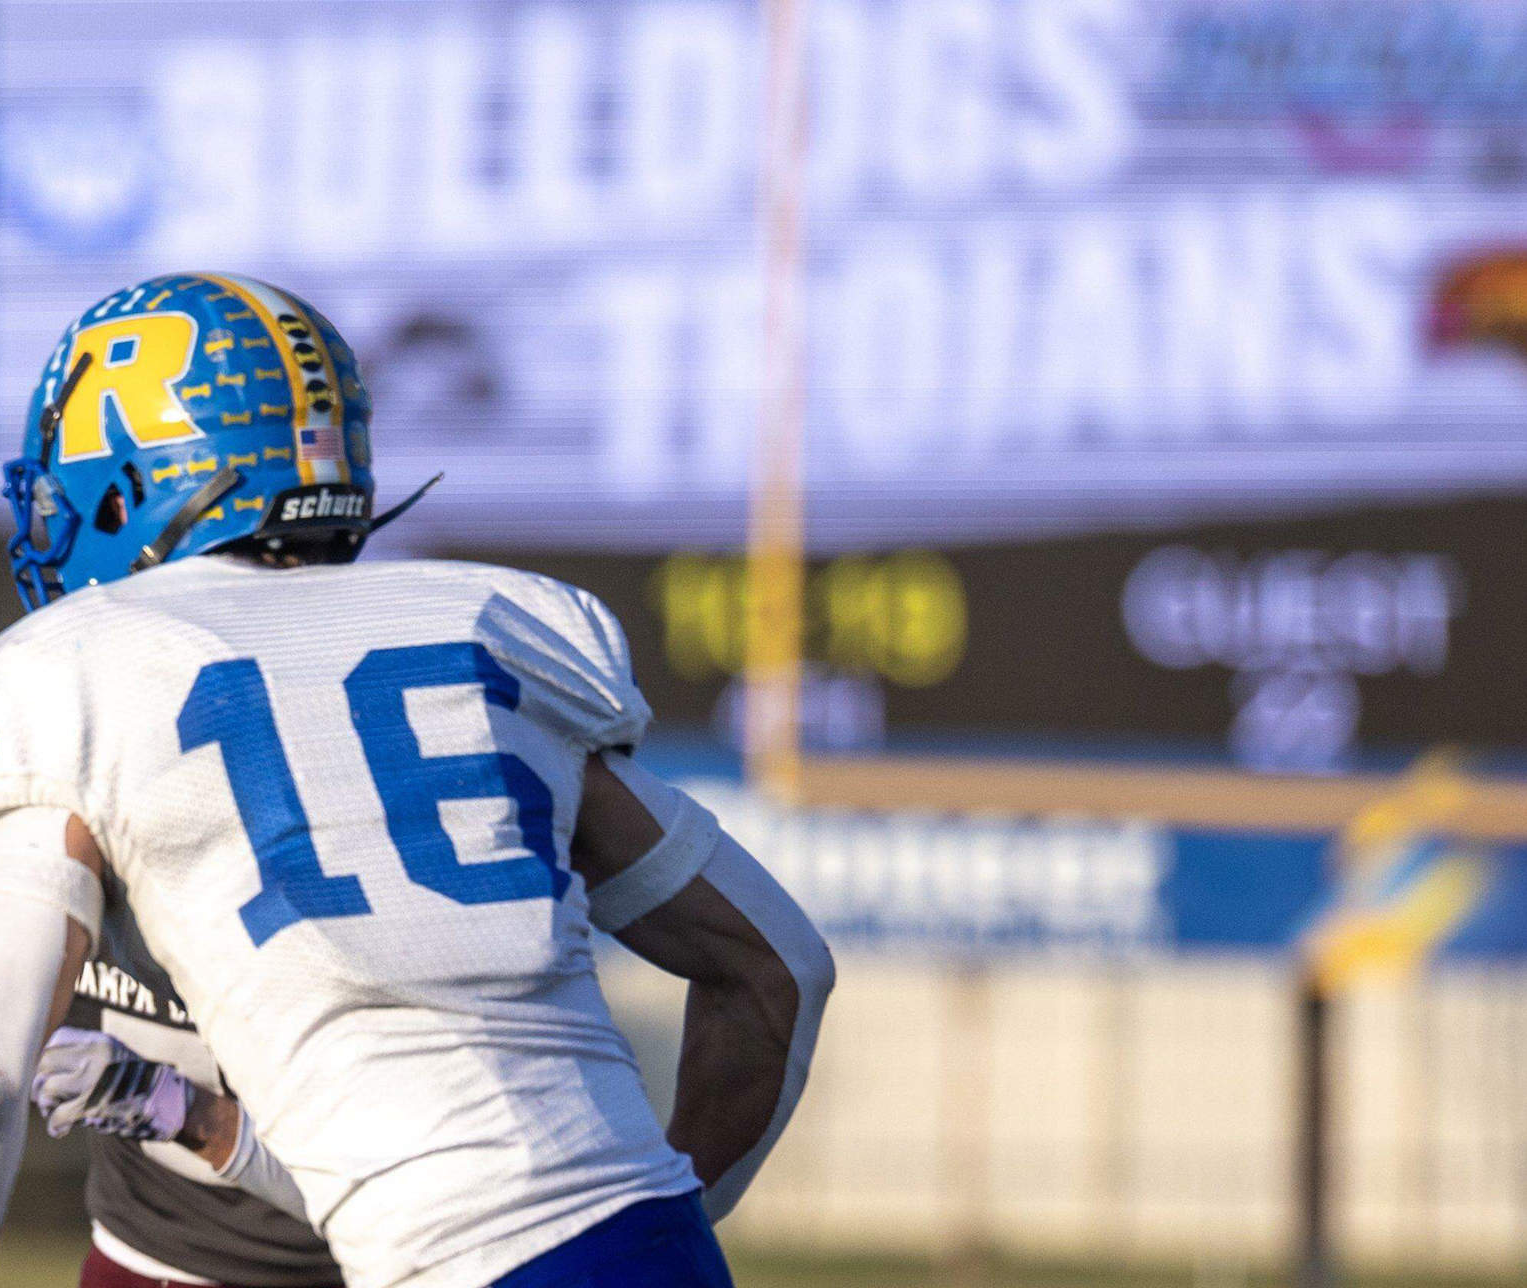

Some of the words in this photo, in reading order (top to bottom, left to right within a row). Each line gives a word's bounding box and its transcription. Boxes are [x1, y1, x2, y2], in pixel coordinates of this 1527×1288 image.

[155, 0, 1137, 258] BULLDOGS
[59, 311, 205, 463] R
[579, 192, 1425, 496] TROJANS
[281, 487, 364, 521] schutt
[177, 642, 572, 948] 16
